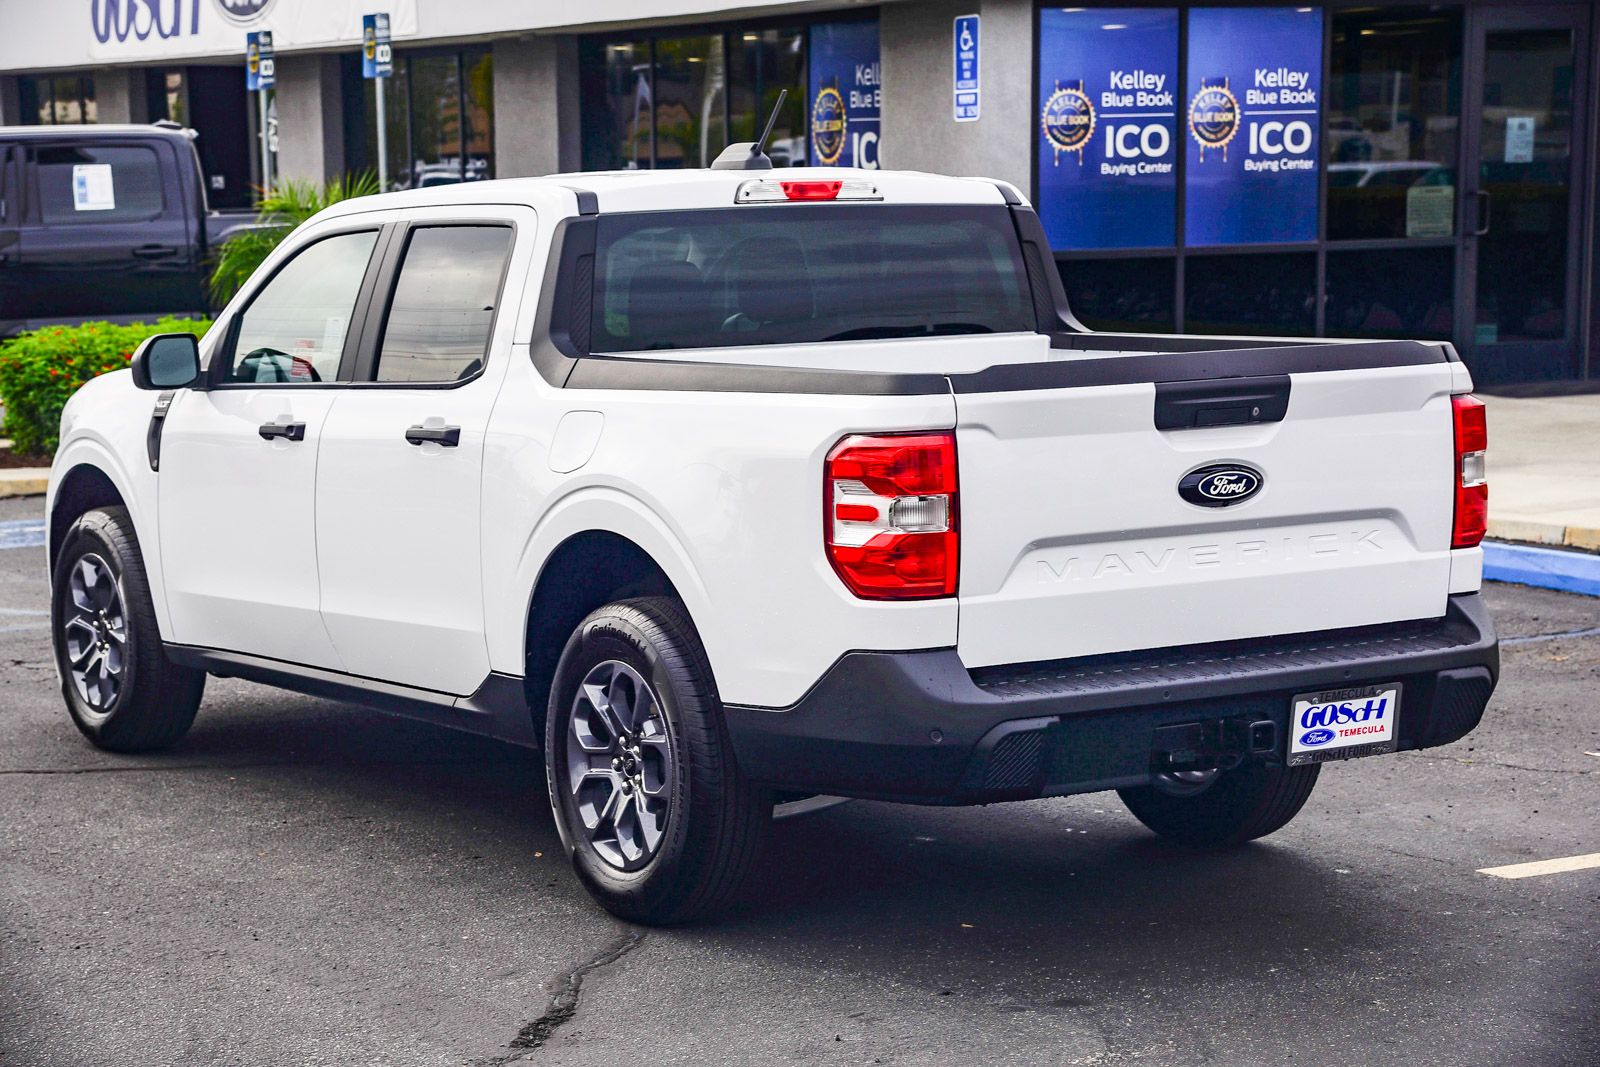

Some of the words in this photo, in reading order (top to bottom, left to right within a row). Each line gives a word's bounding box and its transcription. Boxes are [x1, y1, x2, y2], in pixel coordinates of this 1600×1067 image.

[1110, 70, 1166, 92] Kelley
[1254, 67, 1309, 90] Kelley
[849, 90, 873, 108] Blue
[1101, 92, 1134, 107] Blue
[1136, 90, 1173, 107] Book
[1246, 89, 1278, 105] Blue
[1280, 88, 1316, 104] Book
[1047, 115, 1068, 126] BLUE
[1069, 114, 1089, 125] BOOK
[1194, 112, 1213, 123] BLUE
[1214, 112, 1234, 123] BOOK
[1105, 123, 1170, 158] ICO
[1249, 120, 1312, 155] ICO
[852, 131, 880, 170] IC
[1100, 162, 1137, 176] Buying
[1137, 161, 1173, 173] Center
[1244, 159, 1280, 172] Buying
[1280, 157, 1314, 170] Center
[1210, 475, 1246, 495] Ford
[1035, 529, 1385, 585] MAVERICK
[1319, 686, 1377, 701] TEMECULA
[1339, 725, 1385, 737] TEMECULA
[1347, 744, 1372, 758] FORD
